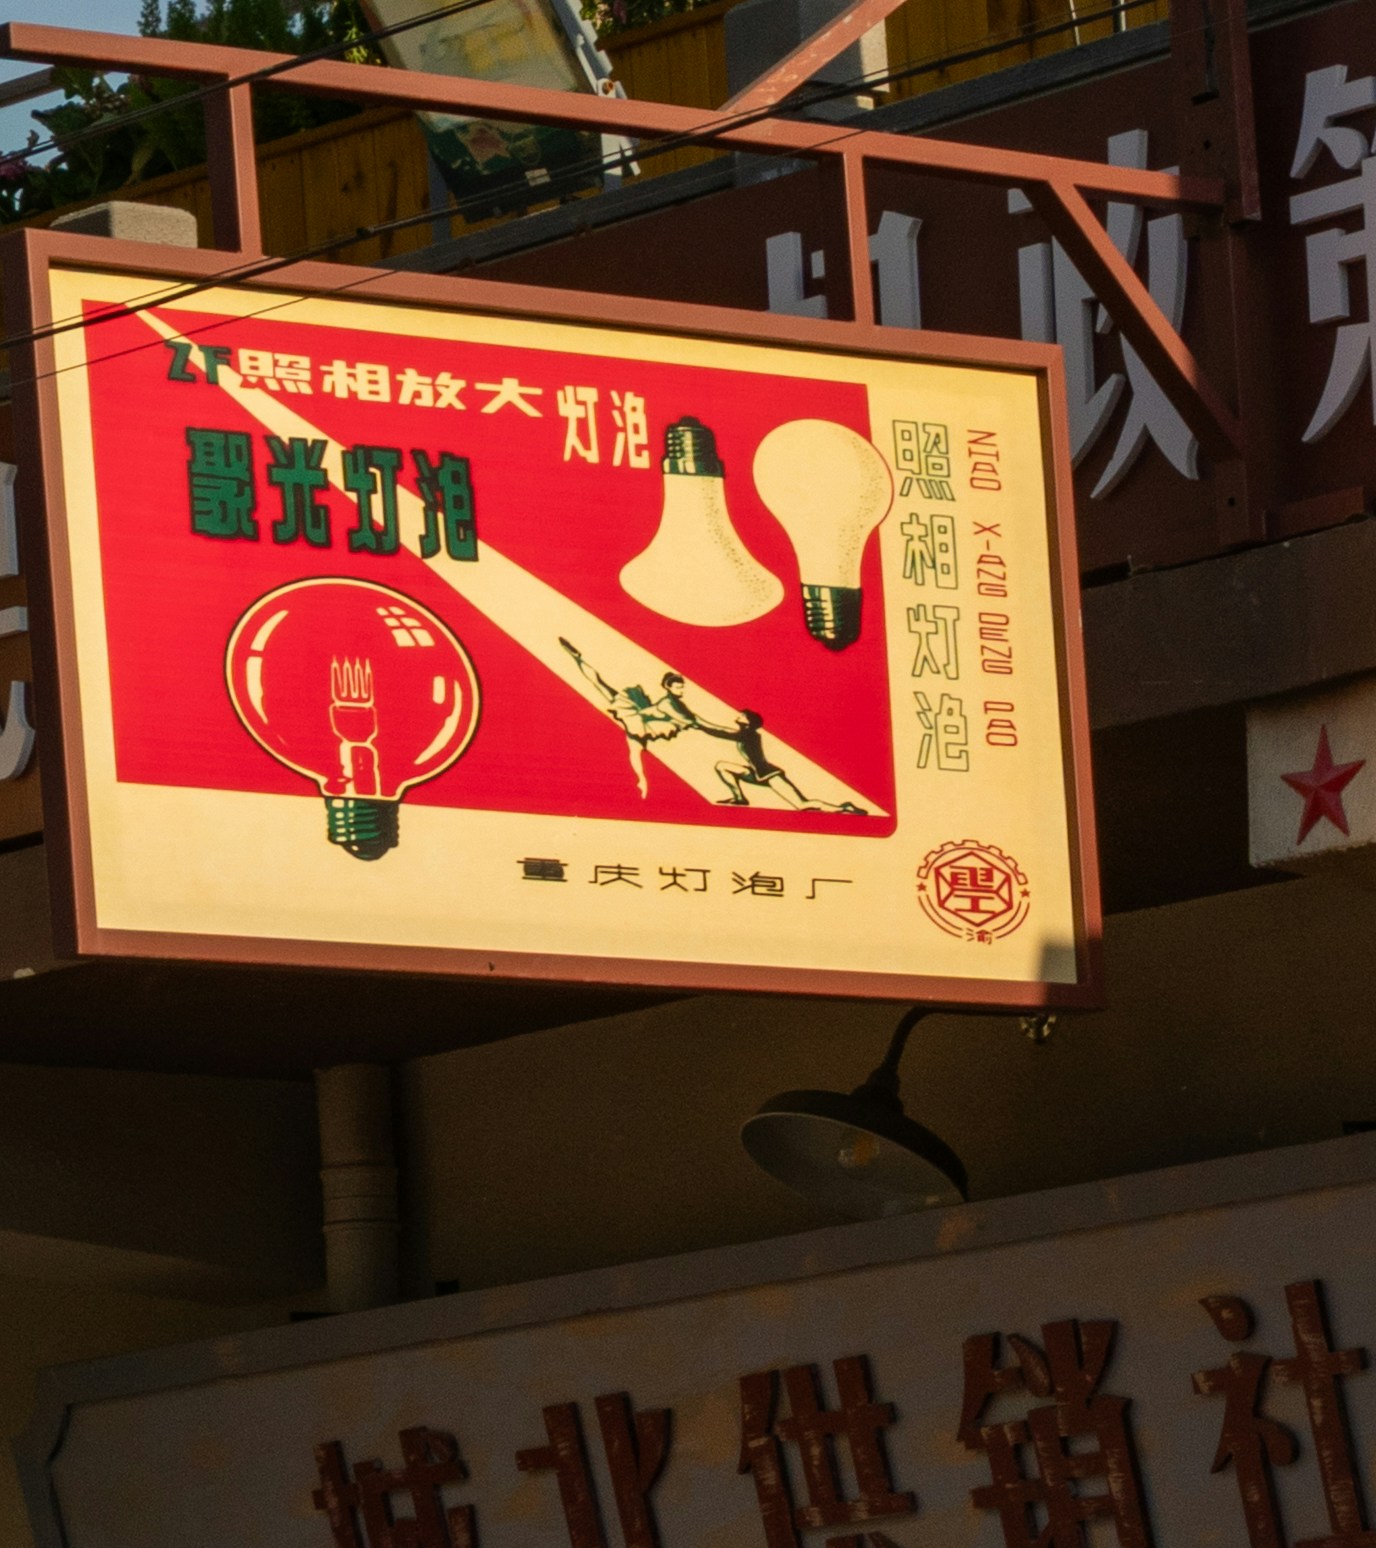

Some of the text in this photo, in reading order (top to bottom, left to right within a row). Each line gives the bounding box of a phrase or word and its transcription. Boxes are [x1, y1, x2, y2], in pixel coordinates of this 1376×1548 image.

[185, 426, 480, 563] 聚光灯泡
[892, 419, 970, 773] 照相灯泡
[516, 856, 853, 900] 重庆灯泡厂
